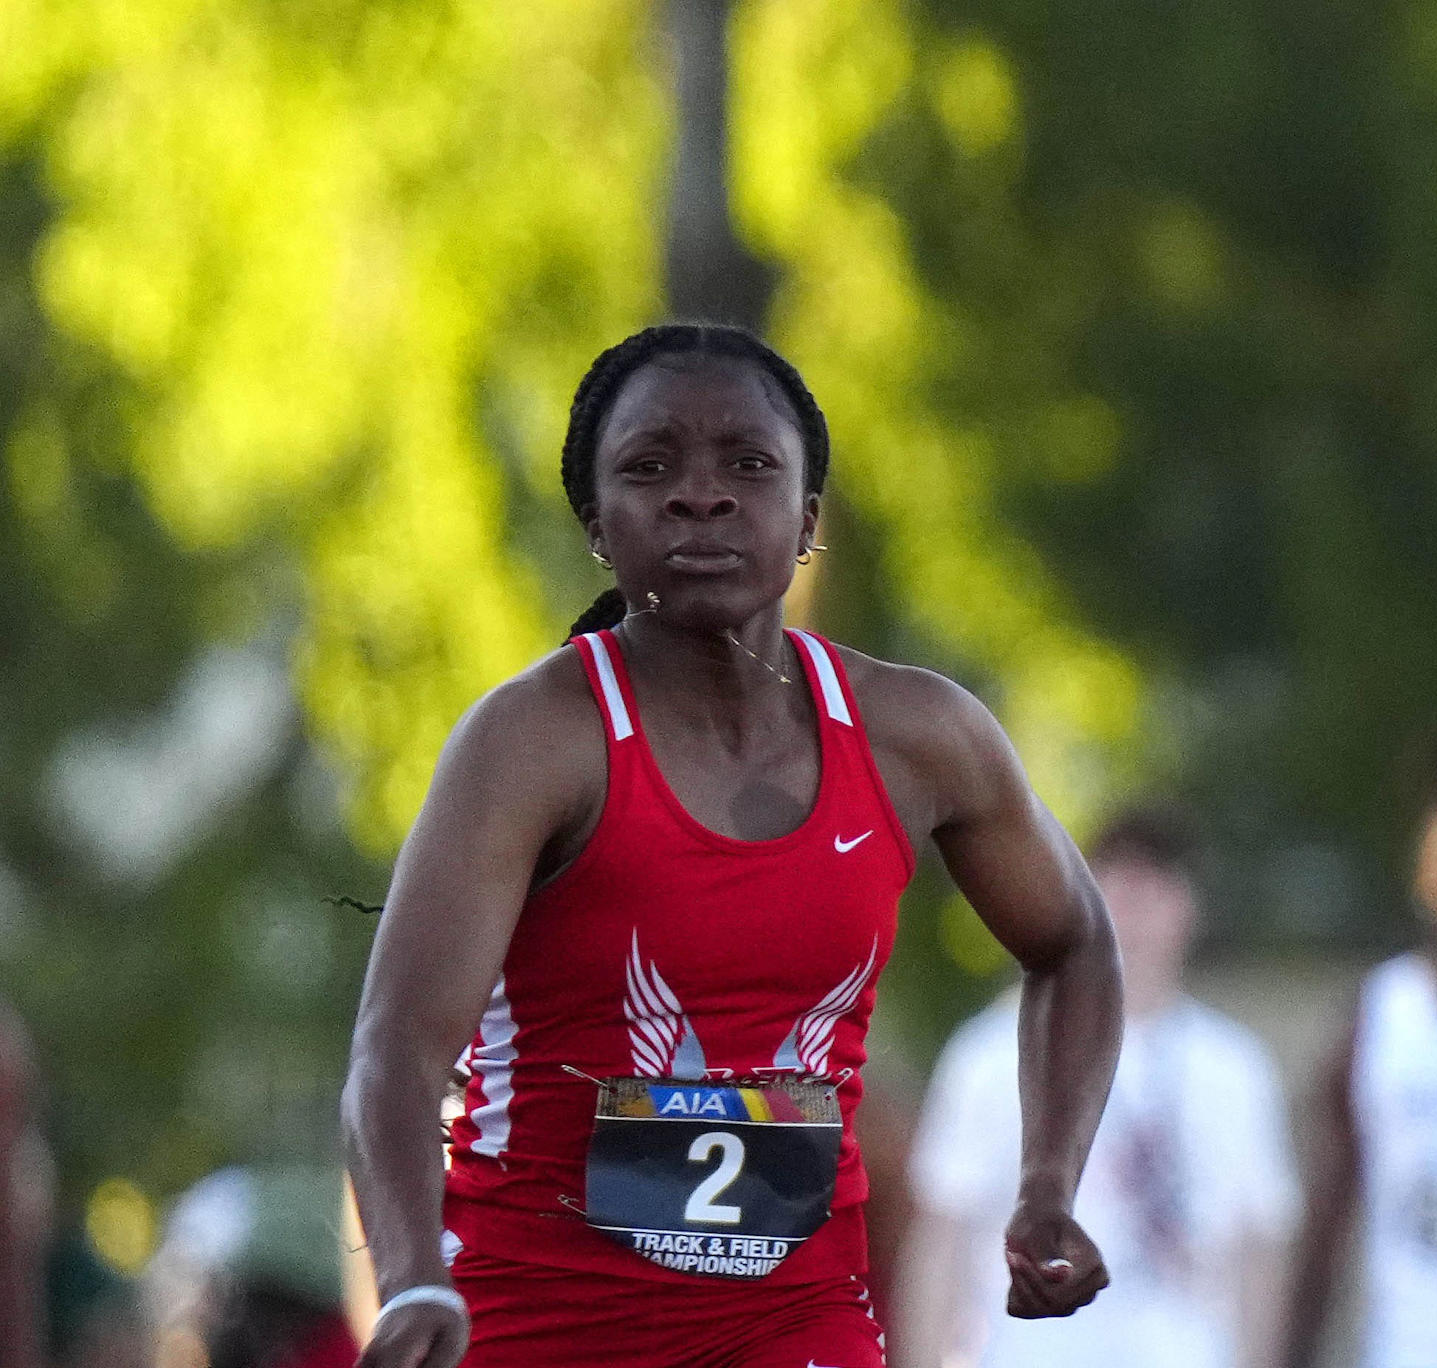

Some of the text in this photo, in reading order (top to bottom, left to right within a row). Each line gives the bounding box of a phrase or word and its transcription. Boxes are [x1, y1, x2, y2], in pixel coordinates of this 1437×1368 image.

[660, 1091, 727, 1116] AIA
[684, 1131, 745, 1223] 2
[632, 1232, 789, 1259] TRACK & FIELD
